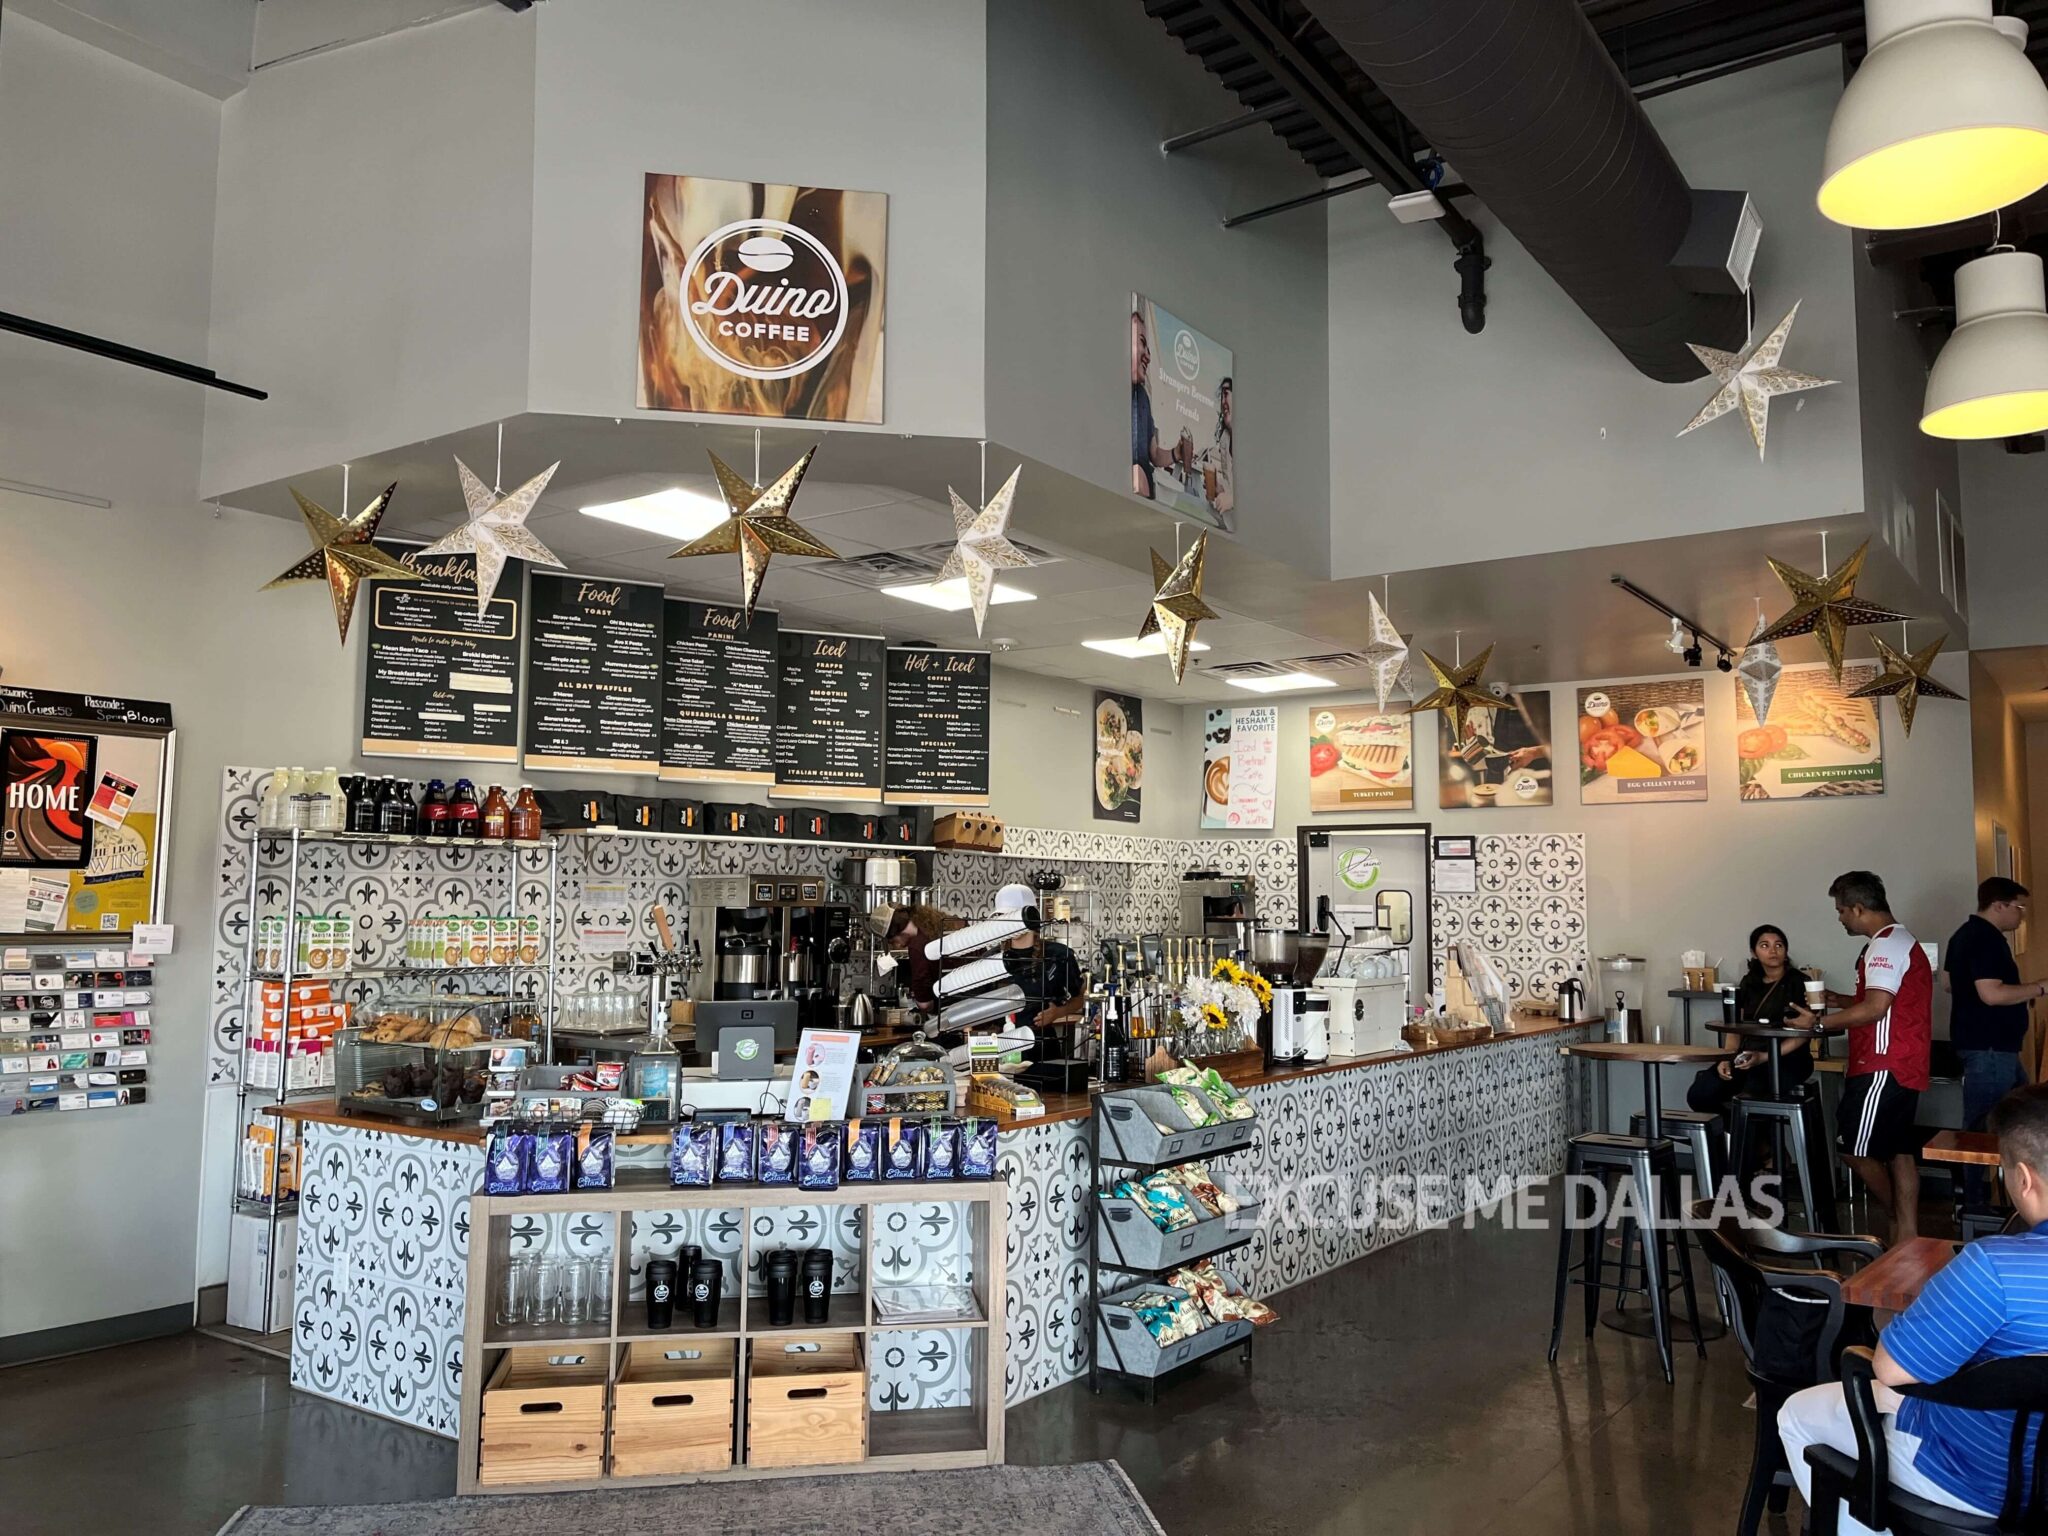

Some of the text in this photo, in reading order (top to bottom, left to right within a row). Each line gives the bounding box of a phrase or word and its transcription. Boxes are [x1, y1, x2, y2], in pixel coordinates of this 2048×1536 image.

[692, 271, 837, 318] Duino
[719, 321, 809, 341] COFFEE
[1159, 367, 1214, 408] Strangers Become
[1176, 399, 1199, 421] Friends
[577, 582, 621, 606] Food
[584, 608, 612, 616] TOAST
[703, 608, 741, 629] Food
[708, 632, 734, 640] PANINI
[813, 639, 847, 657] Iced
[905, 654, 930, 672] Hot
[944, 656, 975, 673] Iced
[388, 669, 415, 677] Breakfast
[0, 687, 33, 699] etwork:
[595, 684, 633, 693] WAFFLES
[84, 695, 125, 710] Passcode:
[1587, 701, 1609, 710] Duino
[679, 710, 726, 718] QUESADILLA
[1250, 709, 1267, 717] ASIL
[1235, 717, 1275, 725] HESHAM'S
[1237, 724, 1275, 732] FAVORITE
[1788, 771, 1821, 779] CHICKEN
[1848, 768, 1874, 776] PANINI
[1516, 782, 1537, 791] Duino
[9, 782, 80, 811] HOME
